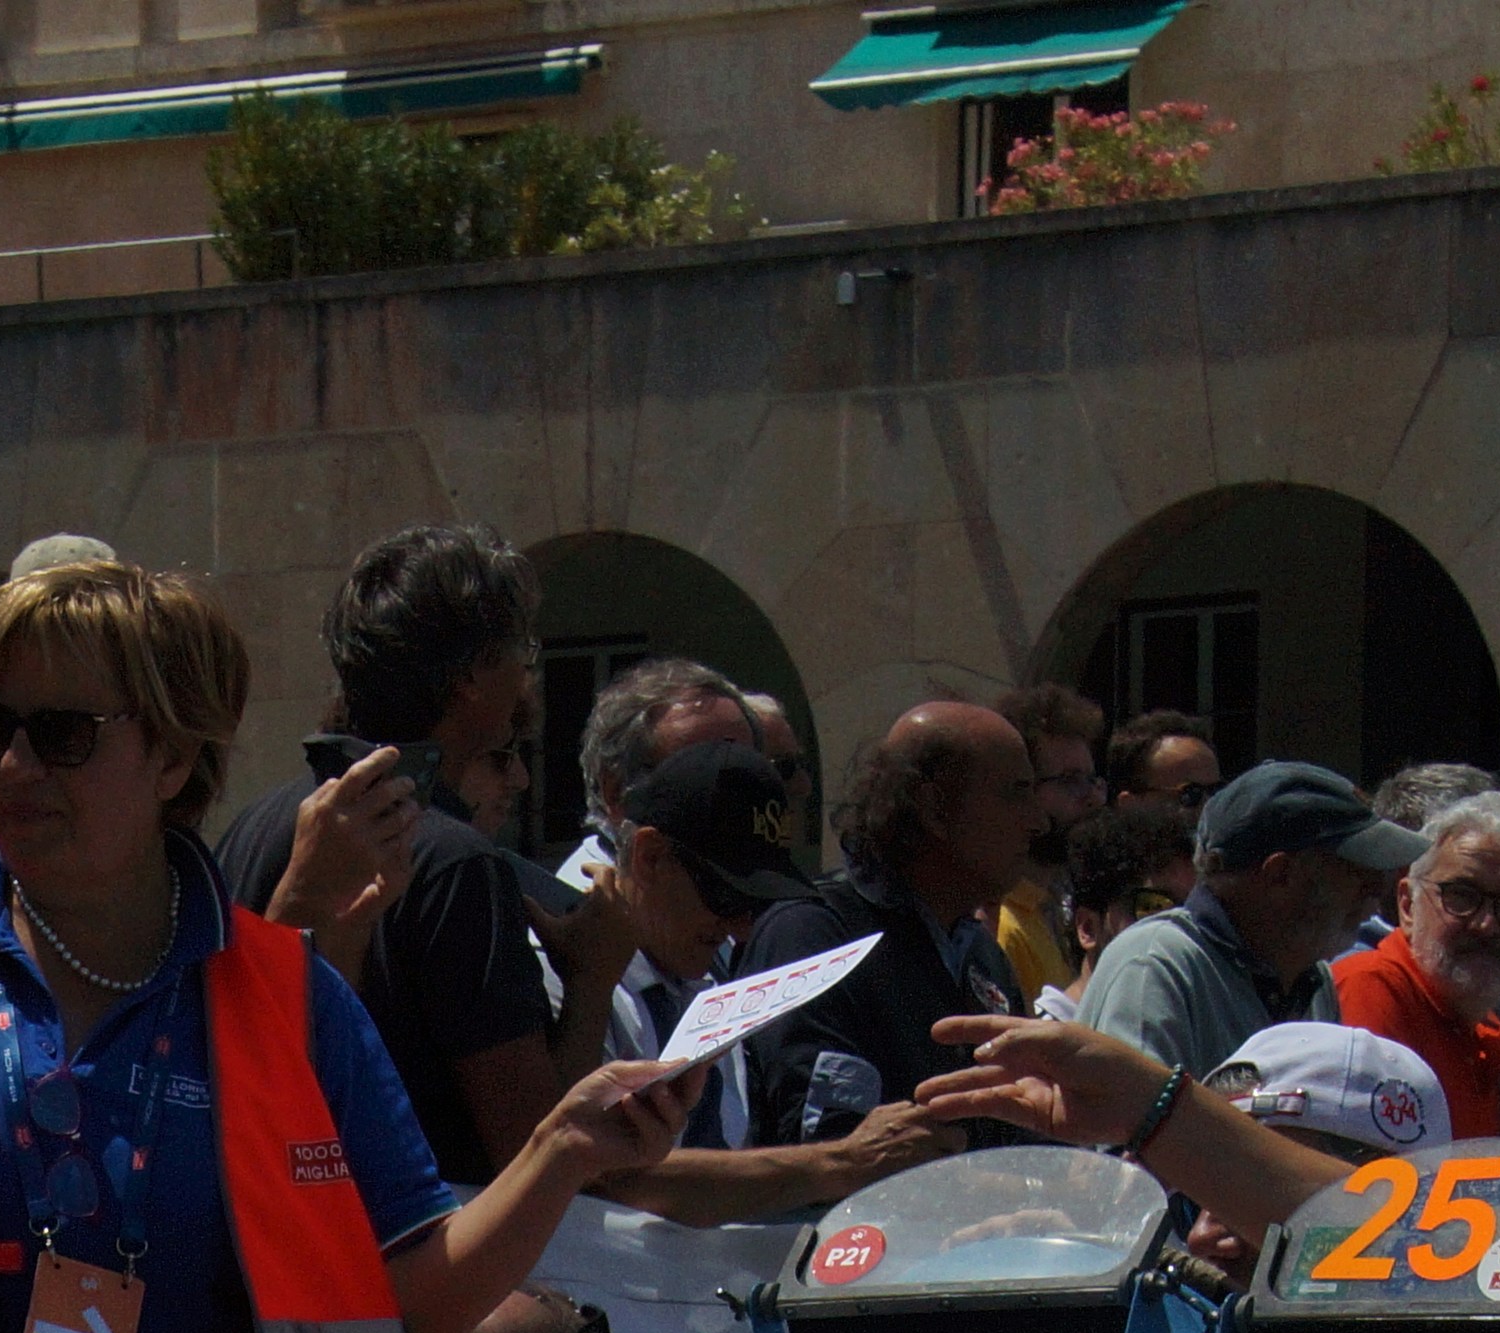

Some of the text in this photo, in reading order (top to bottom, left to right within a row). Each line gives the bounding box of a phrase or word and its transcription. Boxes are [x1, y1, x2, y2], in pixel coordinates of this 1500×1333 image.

[295, 1143, 343, 1161] 1000
[295, 1162, 351, 1180] MIGLIA
[824, 1246, 872, 1268] P21
